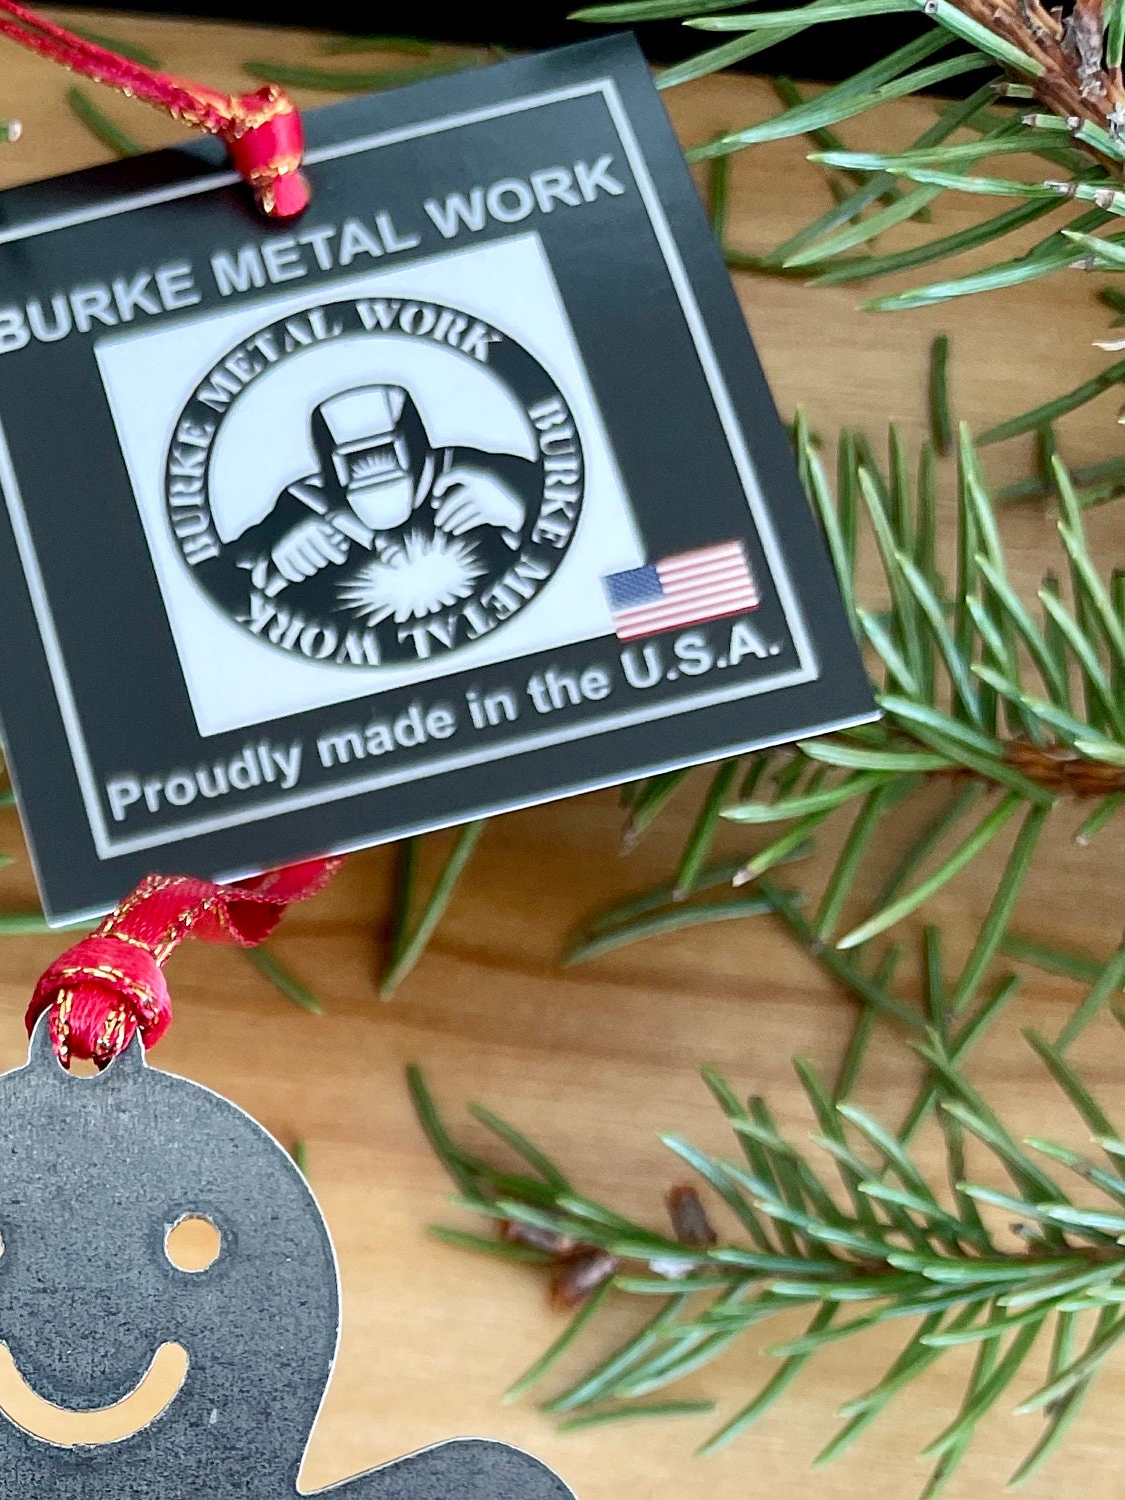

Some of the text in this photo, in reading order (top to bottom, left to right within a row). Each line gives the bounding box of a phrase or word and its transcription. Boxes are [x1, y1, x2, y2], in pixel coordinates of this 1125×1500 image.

[210, 212, 421, 297] METAL
[425, 154, 626, 239] WORK
[168, 301, 503, 566] BURKE METAL WORK
[235, 394, 581, 666] BURKE METAL WORK
[105, 624, 780, 823] Proudly made in the U.S.A.
